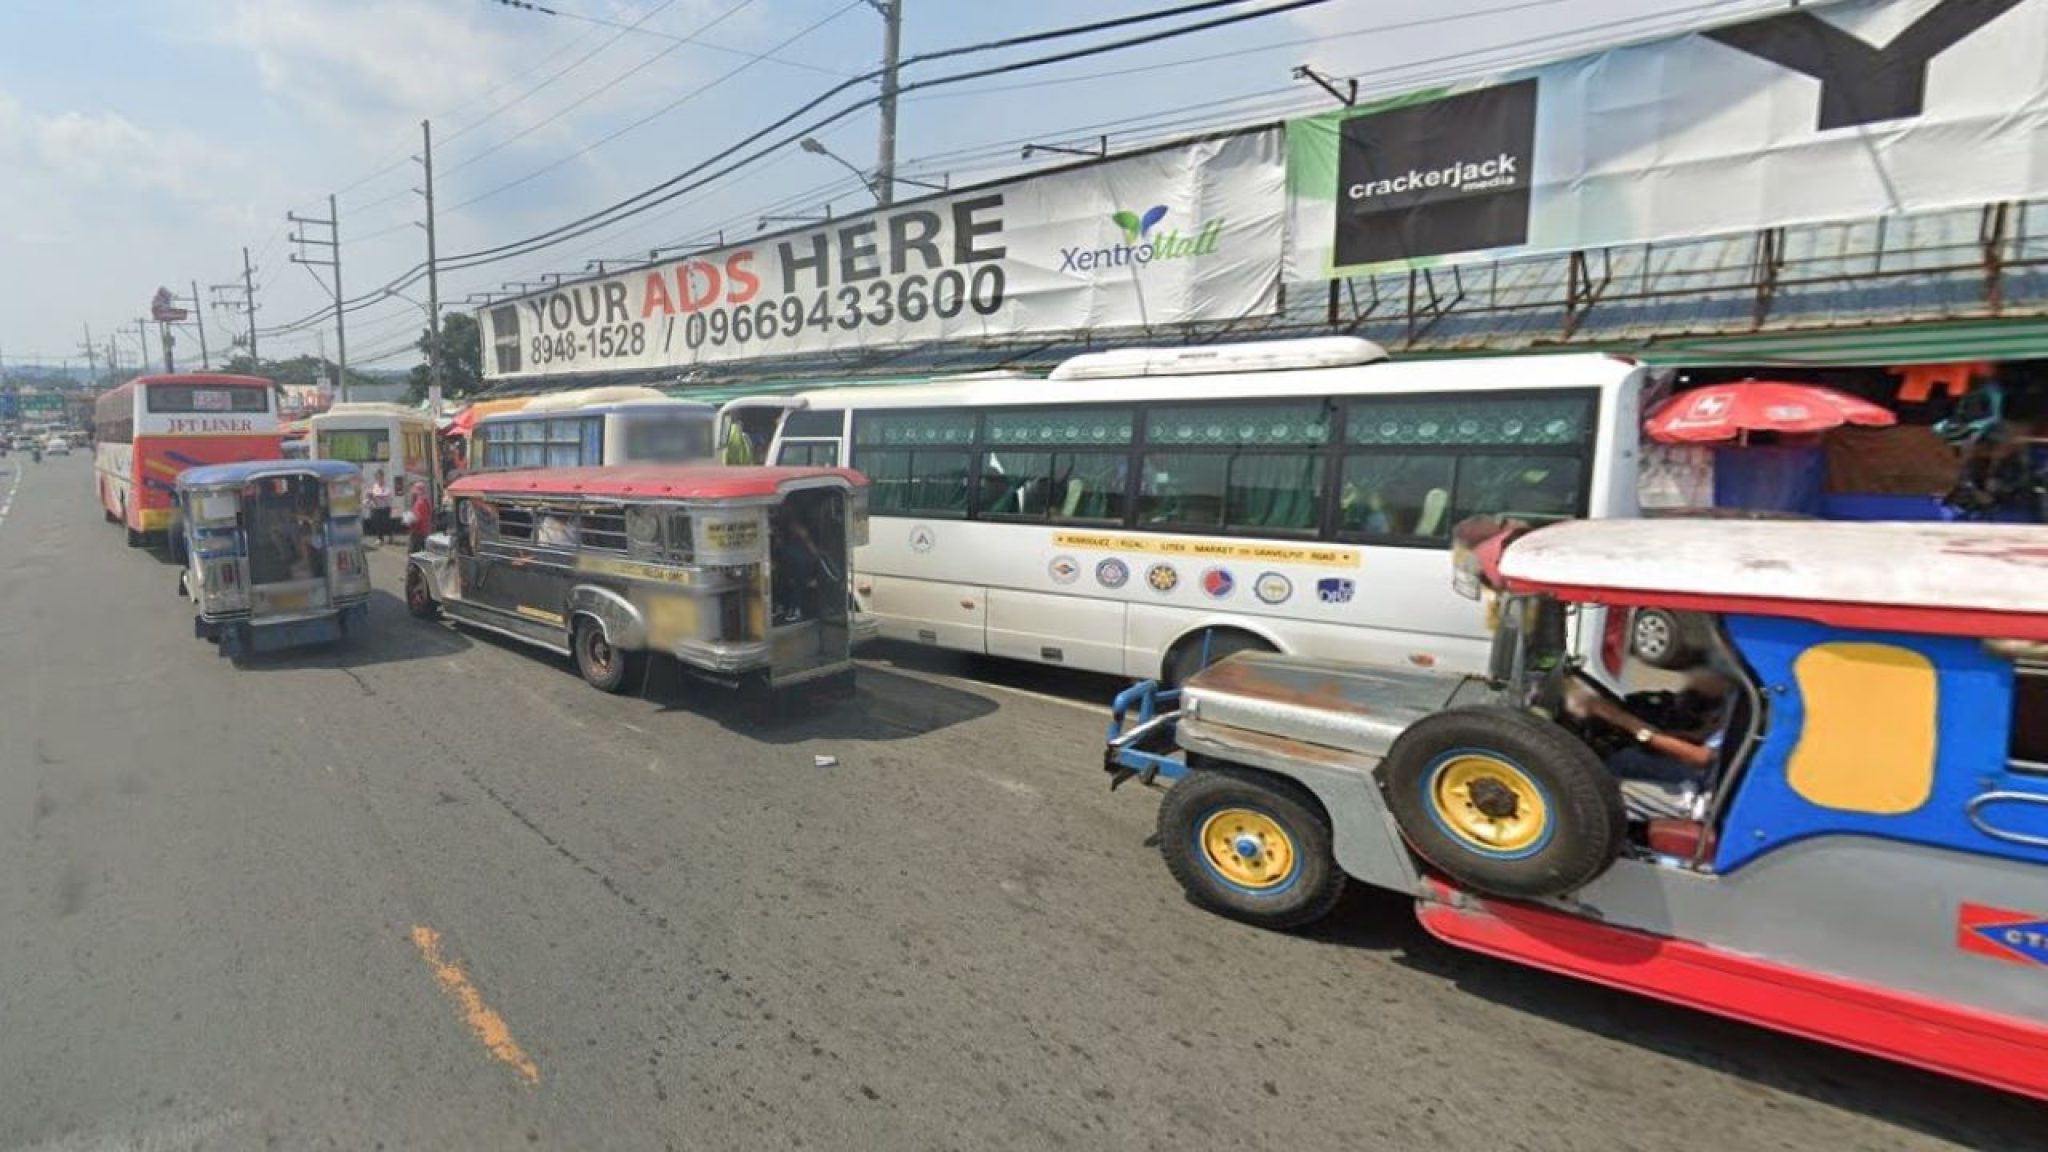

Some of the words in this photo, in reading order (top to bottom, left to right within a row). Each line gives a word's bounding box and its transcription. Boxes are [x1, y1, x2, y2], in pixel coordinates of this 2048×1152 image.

[1697, 0, 2024, 131] Y
[1349, 153, 1516, 199] crackerjack
[1462, 176, 1515, 192] media
[527, 281, 629, 332] YOUR
[641, 250, 759, 318] ADS
[778, 194, 1005, 293] HERE
[531, 322, 645, 365] 8948-1528
[686, 264, 1005, 350] 09669433600
[202, 419, 252, 432] LINER
[1194, 545, 1234, 554] MARKET
[2006, 929, 2048, 950] CT
